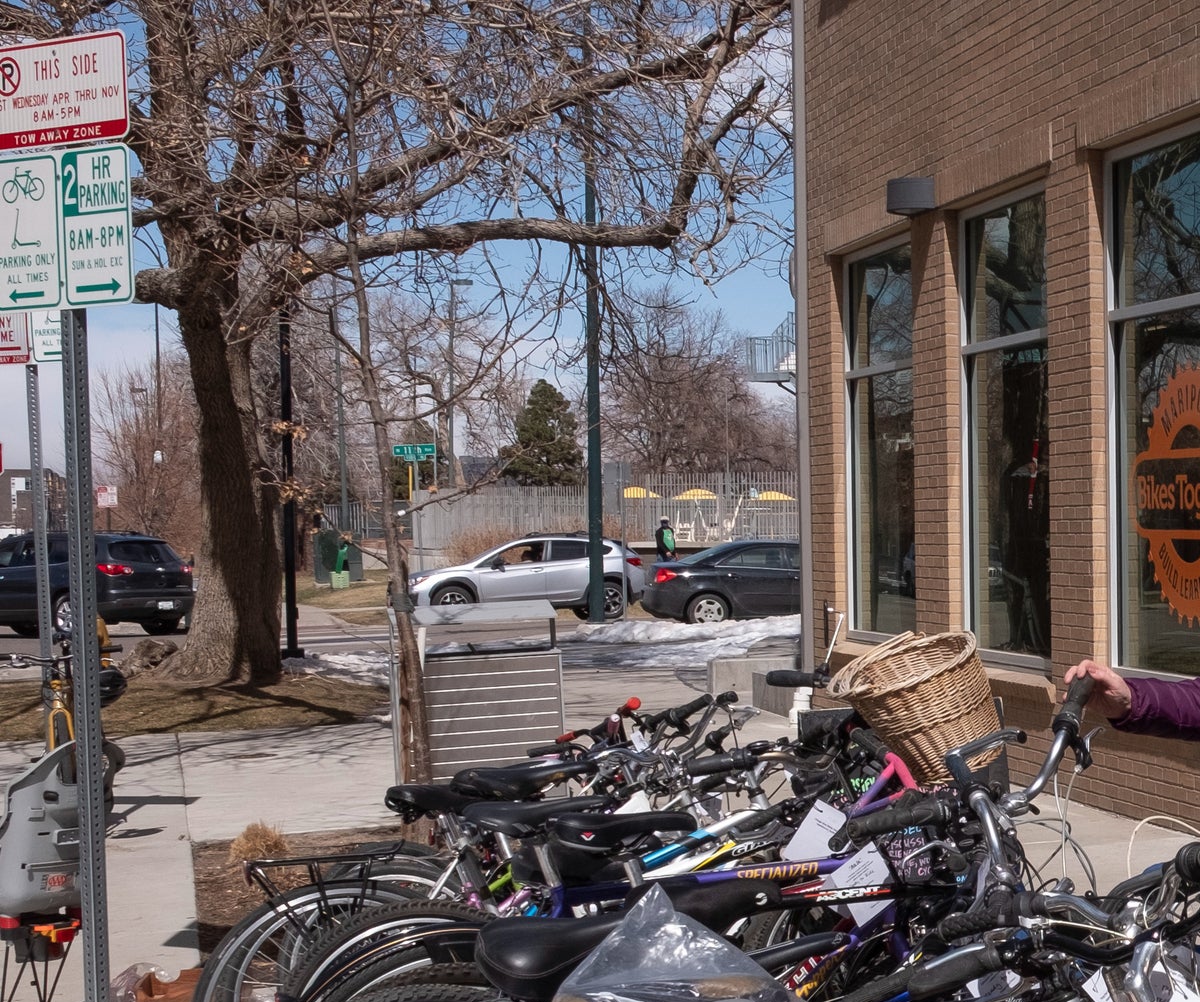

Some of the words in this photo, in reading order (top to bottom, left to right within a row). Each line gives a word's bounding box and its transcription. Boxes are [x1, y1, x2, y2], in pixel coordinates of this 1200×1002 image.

[34, 58, 60, 81] THIS
[72, 53, 98, 76] SIDE
[12, 93, 49, 109] WEDNESDAY
[52, 92, 70, 105] APR
[75, 88, 97, 101] THRU
[102, 85, 120, 97] NOV
[14, 134, 36, 145] TOW
[39, 129, 70, 142] AWAY
[73, 126, 102, 138] ZONE
[91, 155, 111, 180] HR
[63, 163, 77, 205] 2
[79, 180, 125, 208] PARKING
[69, 225, 124, 251] 8AM-8PM
[0, 254, 32, 270] PARKING
[35, 252, 56, 266] ONLY
[71, 259, 86, 271] SUN
[87, 259, 93, 270] &
[94, 257, 108, 269] HOL
[110, 256, 123, 267] EXC
[7, 273, 23, 285] ALL
[26, 272, 49, 283] TIMES
[0, 317, 12, 329] NY
[0, 330, 15, 343] ME
[42, 339, 54, 347] ALL
[1137, 474, 1175, 510] Bikes
[1158, 542, 1179, 592] BUILD.
[737, 862, 818, 880] SPECIALIZED
[816, 886, 880, 902] ASCENT
